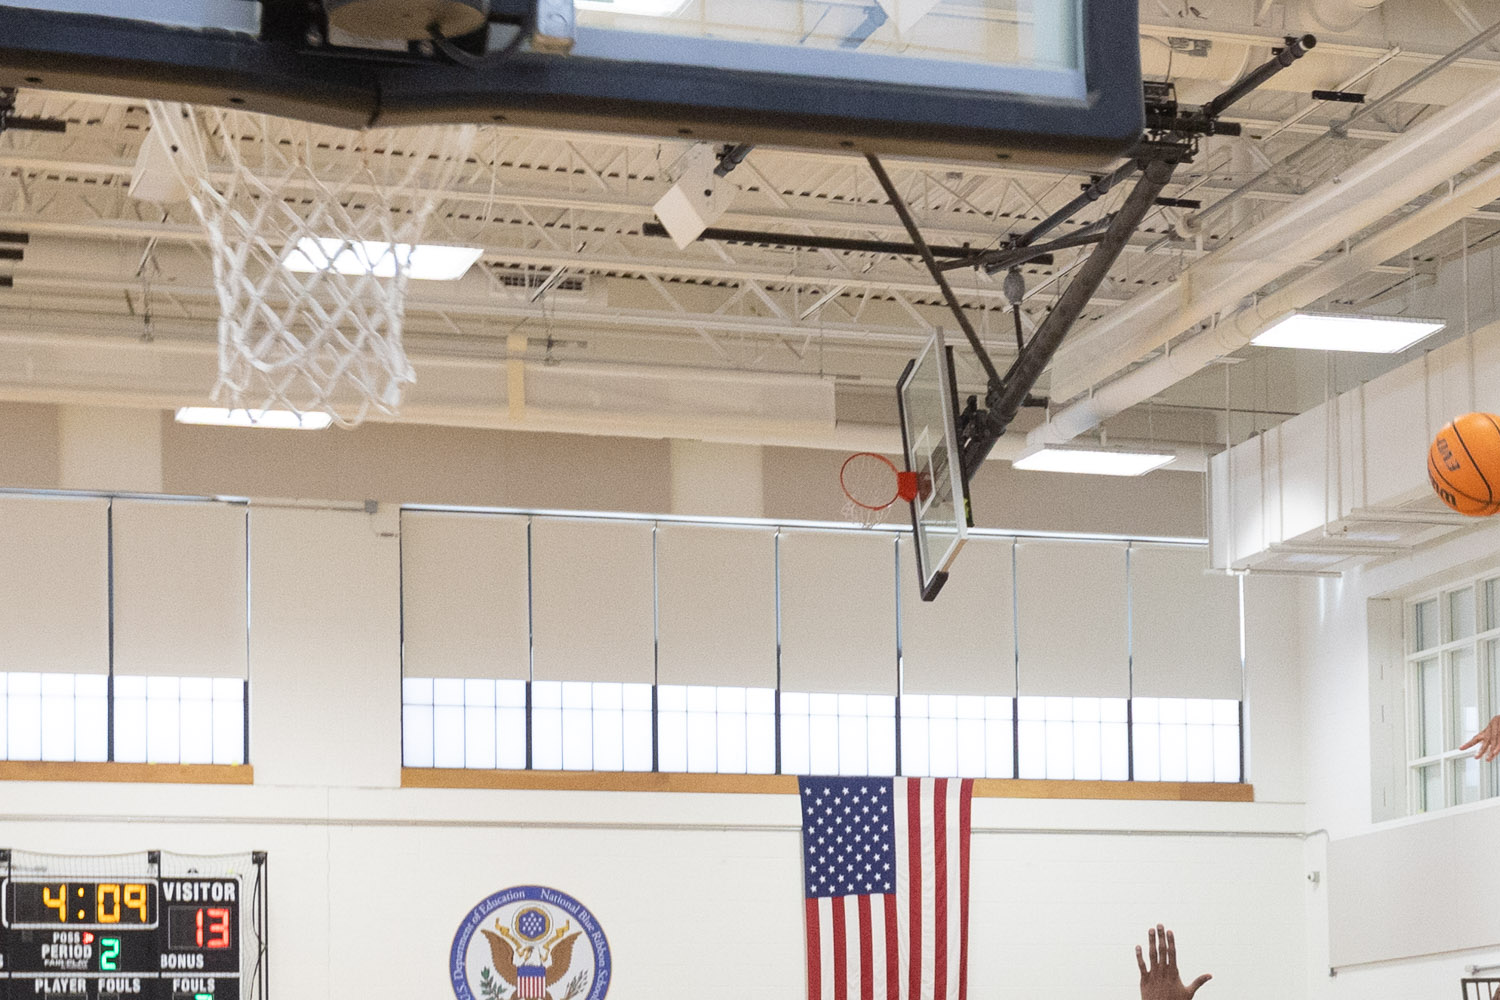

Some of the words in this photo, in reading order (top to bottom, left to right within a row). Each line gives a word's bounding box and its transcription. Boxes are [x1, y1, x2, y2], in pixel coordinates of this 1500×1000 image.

[162, 881, 236, 901] VISITOR
[42, 883, 147, 923] 4:09
[479, 890, 525, 915] Education
[540, 888, 581, 915] National
[578, 910, 595, 932] Blue
[53, 931, 80, 944] POSS
[195, 908, 230, 948] 13
[41, 944, 93, 960] PERIOD
[101, 938, 120, 970] 2
[160, 953, 205, 969] BONUS
[35, 978, 87, 993] PLAYER
[98, 978, 141, 993] FOULS
[173, 978, 216, 993] FOULS
